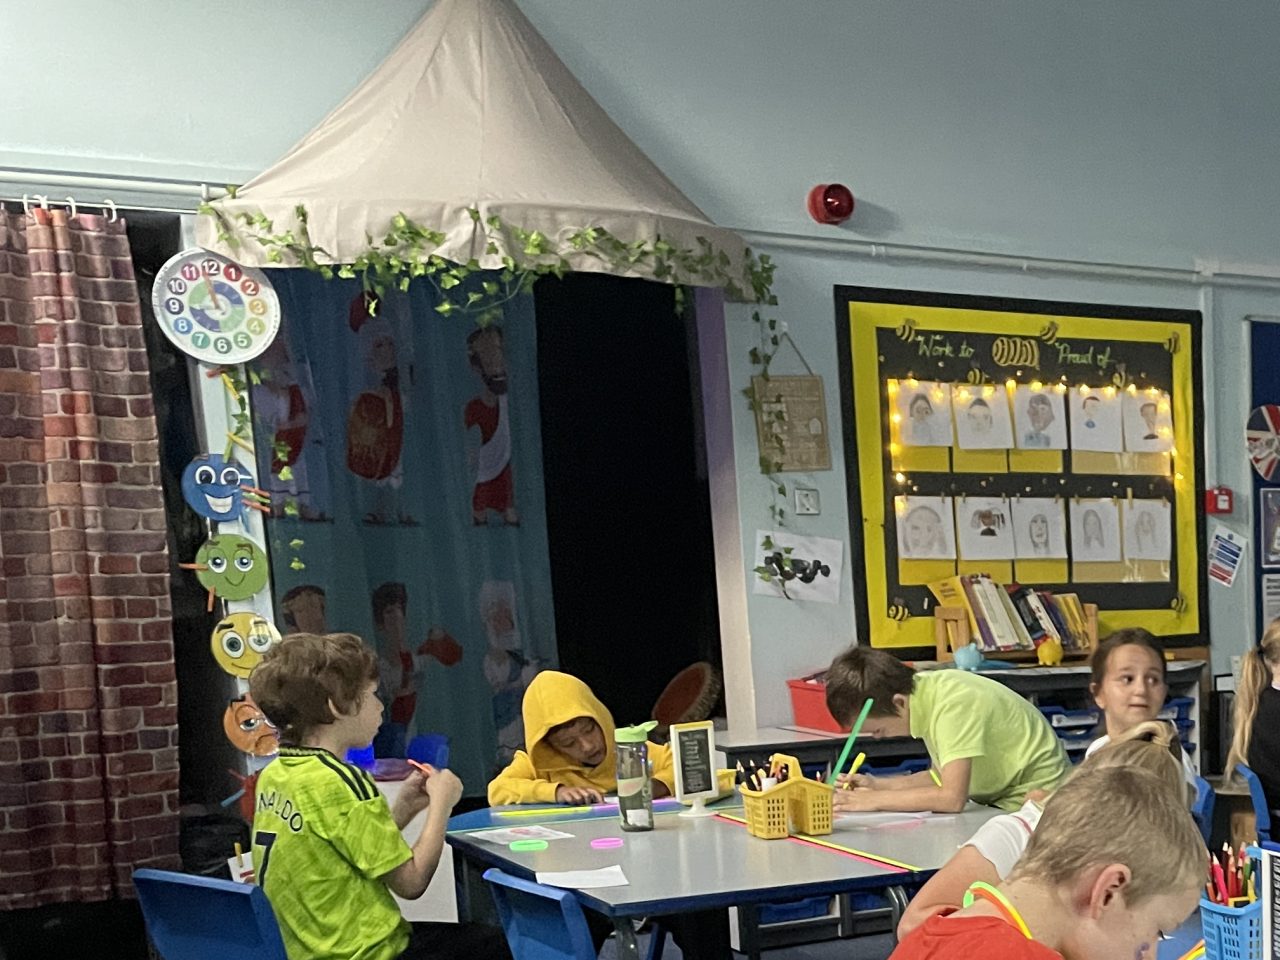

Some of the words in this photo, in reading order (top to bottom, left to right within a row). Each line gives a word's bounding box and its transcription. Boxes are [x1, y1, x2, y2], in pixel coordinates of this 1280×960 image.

[183, 266, 197, 279] 11
[203, 261, 219, 274] 12
[229, 268, 236, 280] 1
[170, 281, 185, 293] 10
[245, 282, 256, 295] 2
[169, 299, 180, 313] 9
[253, 300, 264, 313] 3
[178, 319, 189, 333] 8
[251, 321, 262, 334] 4
[195, 334, 204, 348] 7
[218, 339, 228, 352] 6
[238, 334, 248, 346] 5
[915, 335, 954, 357] Work
[958, 340, 976, 358] to
[1056, 343, 1094, 365] Proud
[1097, 346, 1118, 368] of
[255, 831, 277, 888] 7
